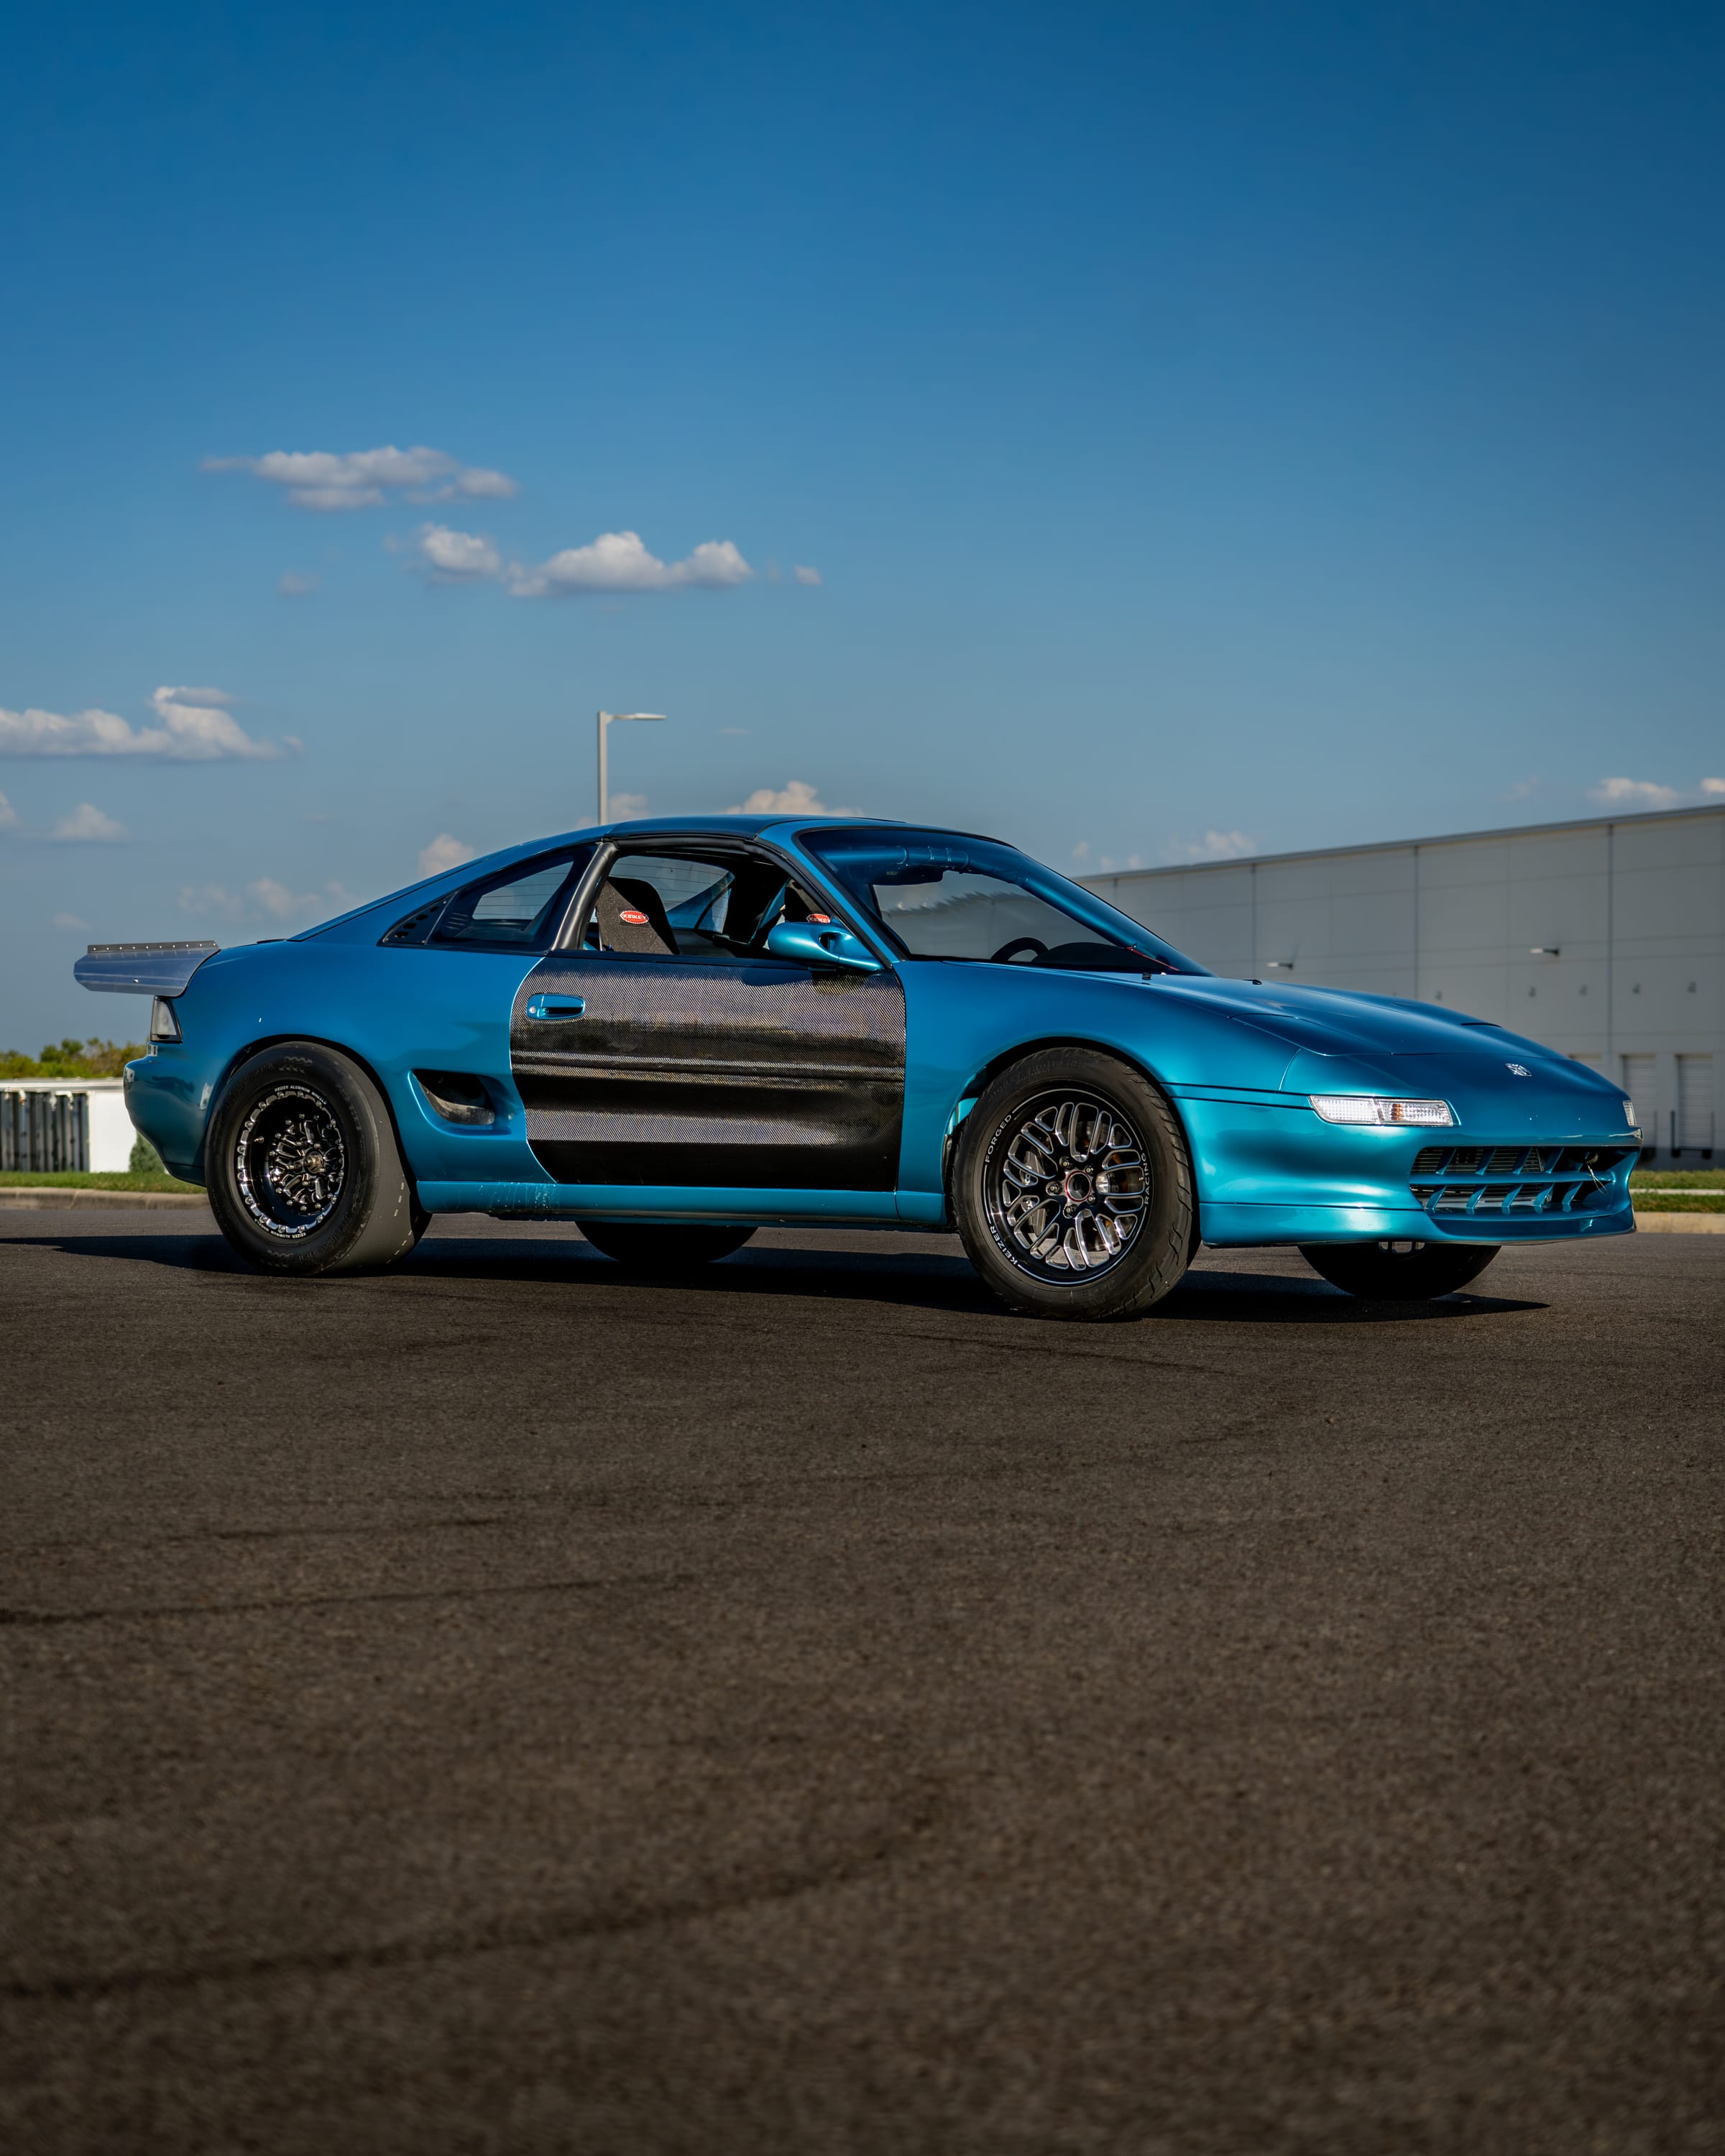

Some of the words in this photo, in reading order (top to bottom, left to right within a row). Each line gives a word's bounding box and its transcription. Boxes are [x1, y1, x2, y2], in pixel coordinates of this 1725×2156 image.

[985, 1115, 1012, 1163] FORGED
[1141, 1152, 1150, 1204] RACING
[990, 1225, 1018, 1265] KEIZER
